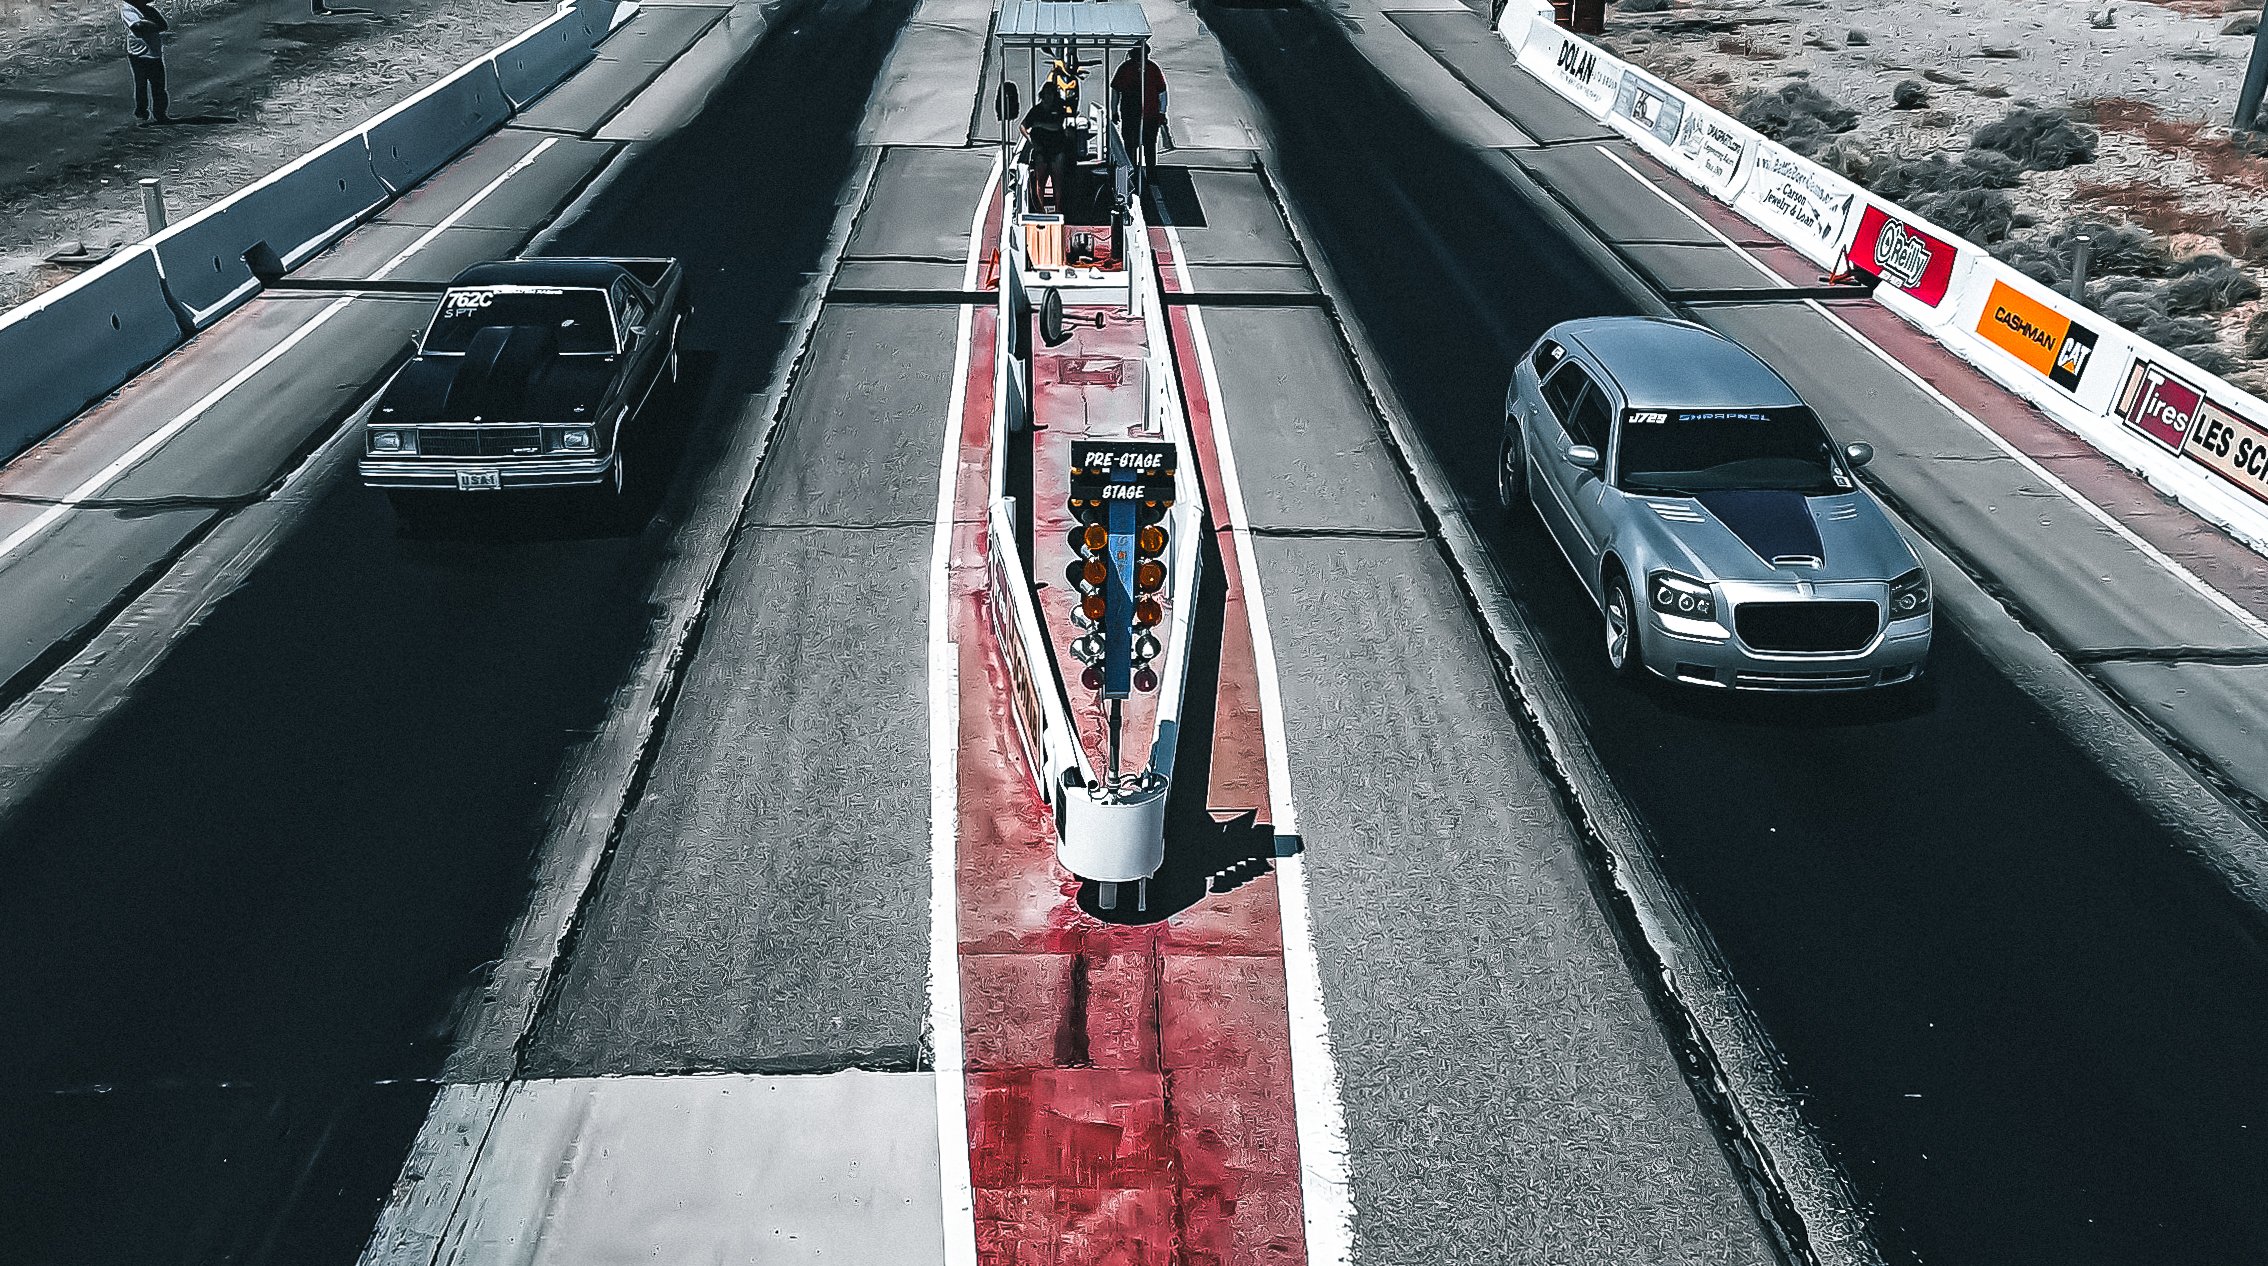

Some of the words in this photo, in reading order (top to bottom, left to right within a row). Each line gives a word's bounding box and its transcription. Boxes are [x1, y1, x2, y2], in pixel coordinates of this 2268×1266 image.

[1557, 39, 1597, 84] DOLAN
[1763, 189, 1791, 215] Jewelry
[1790, 205, 1797, 217] &
[1796, 207, 1815, 228] Loan
[1783, 183, 1807, 206] Carson
[1878, 223, 1927, 283] O'Reilly
[447, 291, 494, 308] 762C
[1995, 306, 2056, 350] CASHMAN
[2058, 337, 2092, 376] CAT
[1629, 412, 1667, 424] J729
[2135, 368, 2189, 432] Tires
[2192, 413, 2234, 458] LES
[1085, 452, 1163, 468] PRE-STAGE
[1102, 485, 1145, 499] STAGE
